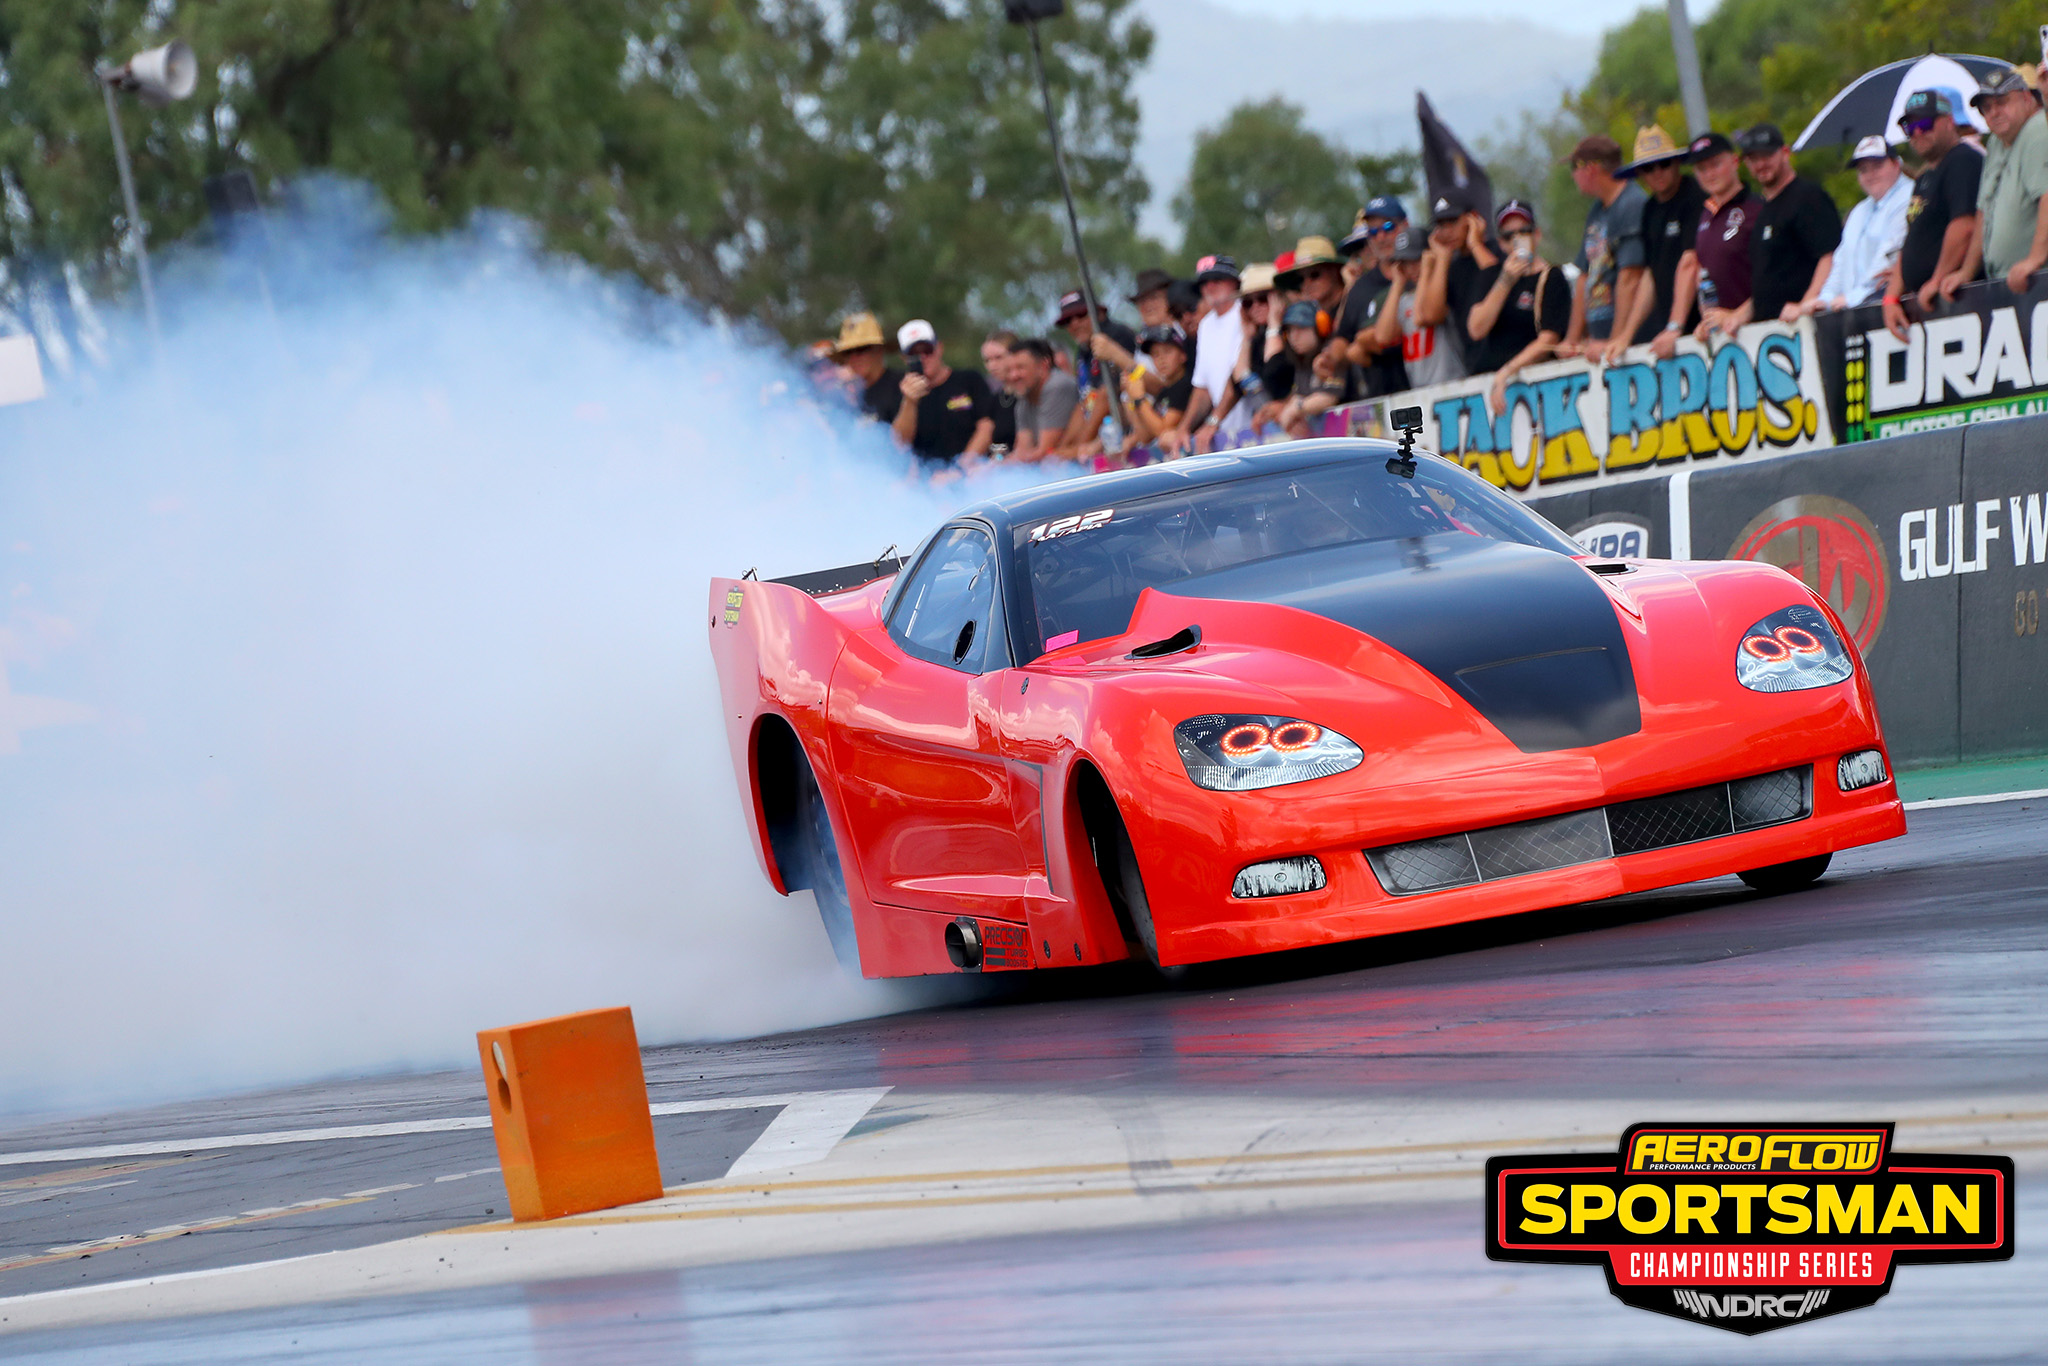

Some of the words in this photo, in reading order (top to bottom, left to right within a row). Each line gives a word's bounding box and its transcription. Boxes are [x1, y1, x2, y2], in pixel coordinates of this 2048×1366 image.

[1433, 372, 1600, 491] JACK
[1603, 332, 1818, 474] BROS.
[1027, 508, 1115, 542] 122
[1900, 498, 2001, 582] GULF
[985, 926, 1028, 947] PRECISION
[1006, 948, 1029, 958] TURBO
